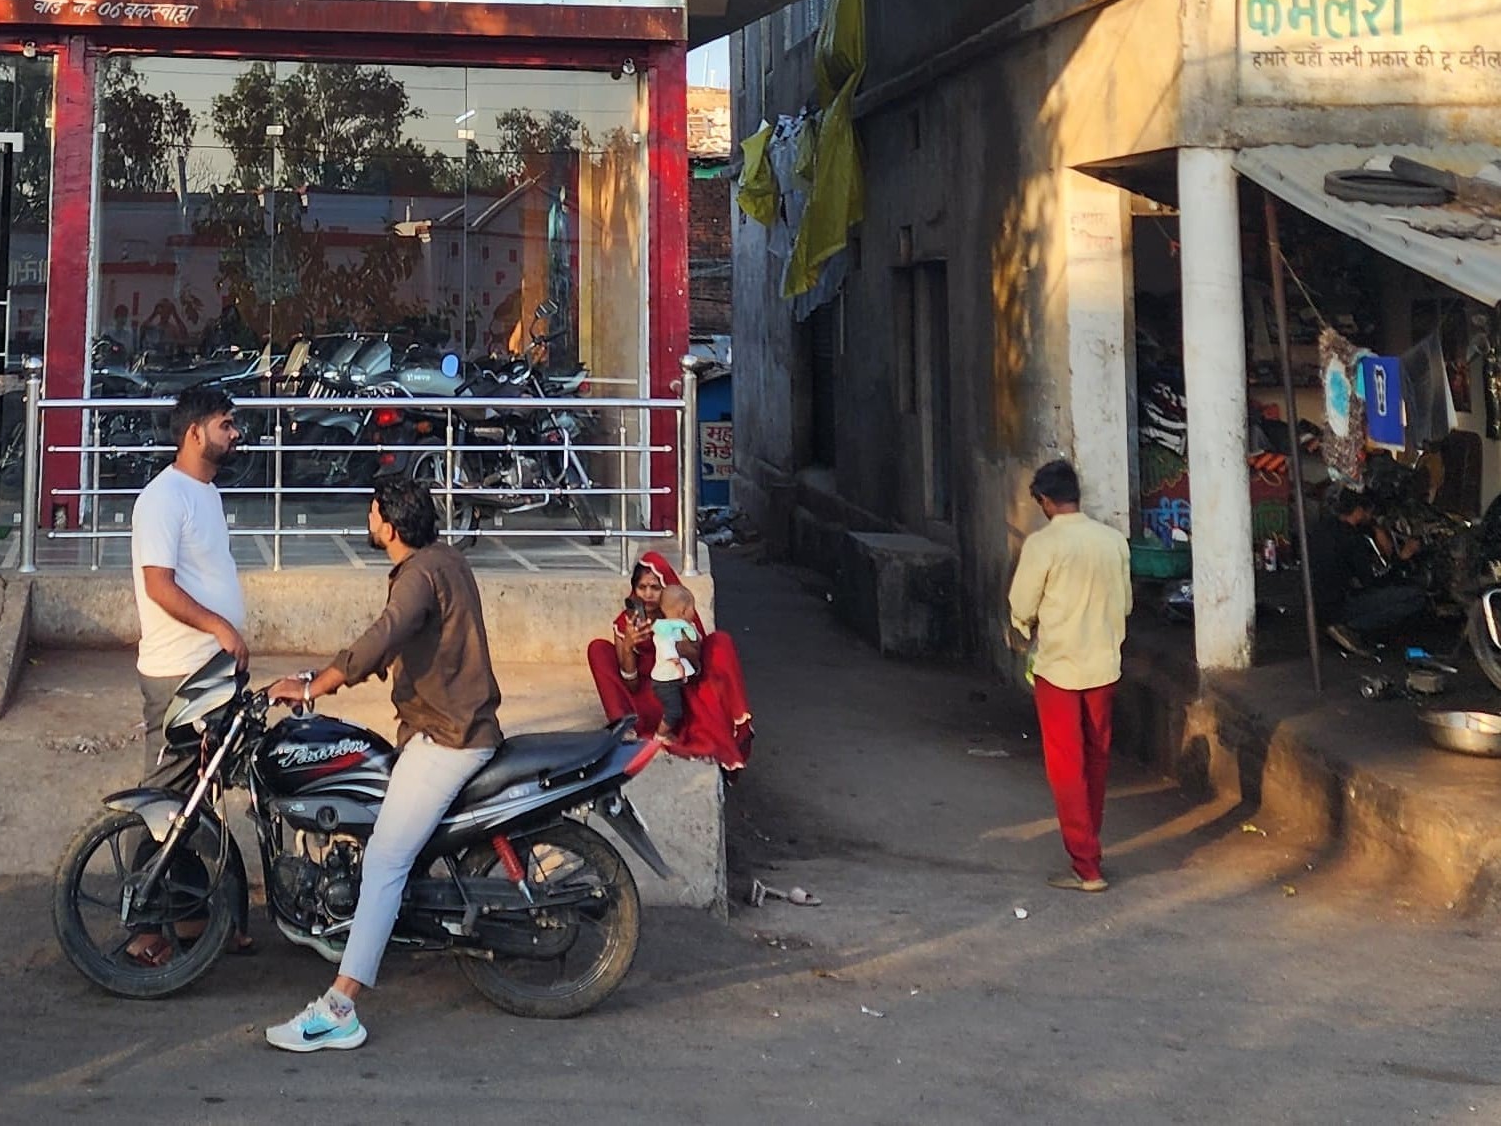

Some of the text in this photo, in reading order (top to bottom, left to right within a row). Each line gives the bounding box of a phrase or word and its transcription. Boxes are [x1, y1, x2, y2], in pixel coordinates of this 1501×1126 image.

[1252, 48, 1287, 68] हमारे
[1329, 45, 1362, 68] सभी
[1368, 50, 1410, 68] प्रकार
[1414, 45, 1435, 67] की
